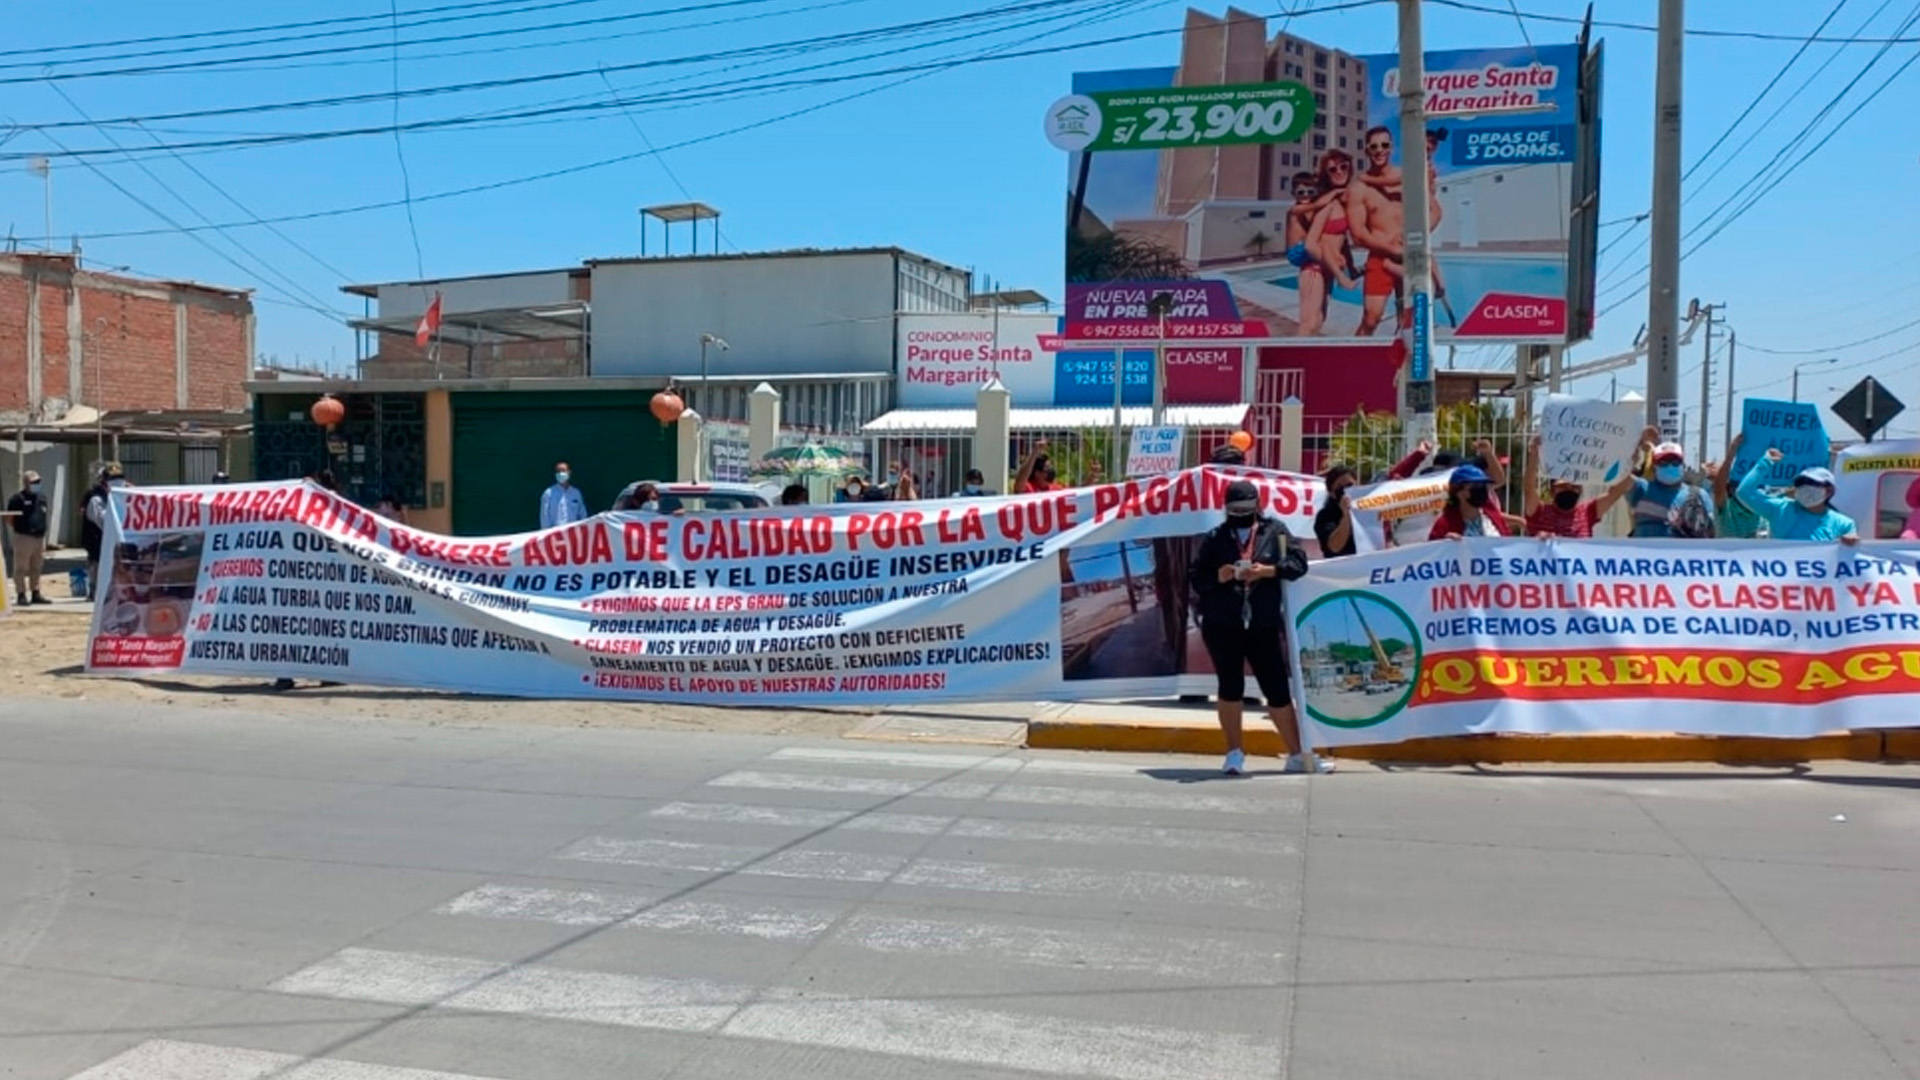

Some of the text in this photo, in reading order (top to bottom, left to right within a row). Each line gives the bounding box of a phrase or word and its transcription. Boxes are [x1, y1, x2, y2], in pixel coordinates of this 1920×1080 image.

[1423, 67, 1553, 93] rque Santa
[1138, 97, 1156, 105] DEL
[1467, 130, 1550, 145] DEPAS DE
[1465, 142, 1565, 160] 3 DORMS.
[1086, 290, 1147, 304] NUEVA
[1084, 304, 1210, 318] EN PRENTA
[1483, 303, 1549, 319] CLASEM
[907, 331, 994, 343] CONDOMINIO
[1094, 324, 1117, 337] 947
[1117, 324, 1140, 337] 556
[1172, 322, 1244, 337] 924 157 538
[907, 345, 1033, 363] Parque Santa
[1166, 351, 1228, 365] CLASEM
[906, 366, 1001, 386] Margarita
[1075, 361, 1098, 372] 947
[1125, 361, 1149, 372] 820
[1075, 374, 1098, 385] 924
[1125, 374, 1148, 385] 538
[123, 491, 200, 531] ¡SANTA
[209, 487, 380, 543] MARGARITA
[389, 527, 513, 568] QUIERE
[523, 521, 614, 567] AGUA
[624, 520, 669, 562] DE
[682, 514, 835, 562] CALIDAD
[846, 511, 925, 552] POR
[937, 507, 986, 544] LA
[997, 492, 1078, 542] QUE
[211, 558, 263, 580] QUEREMOS
[268, 558, 347, 581] CONECCIÓN
[350, 563, 367, 584] DE
[212, 533, 229, 552] EL
[234, 530, 284, 550] AGUA
[292, 531, 339, 554] QUE
[342, 541, 389, 564] NOS
[395, 558, 508, 589] BRINDAN
[512, 573, 547, 592] NO
[554, 573, 583, 592] ES
[591, 570, 697, 590] POTABLE
[704, 569, 720, 588] Y
[728, 567, 757, 587] EL
[765, 555, 881, 587] DESAGÜE
[889, 541, 1046, 577] INSERVIBLE
[1369, 567, 1396, 585] EL
[1402, 560, 1462, 582] AGUA
[1470, 558, 1503, 577] DE
[1509, 557, 1587, 577] SANTA
[1595, 558, 1744, 578] MARGARITA
[1752, 559, 1788, 578] NO
[1795, 560, 1826, 579] ES
[1834, 559, 1907, 580] APTA
[217, 586, 230, 605] AL
[232, 586, 267, 606] AGUA
[272, 588, 322, 609] TURBIA
[324, 590, 351, 611] QUE
[354, 592, 381, 613] NOS
[385, 594, 416, 615] DAN.
[592, 578, 969, 613] EXIGIMOS QUE LA EPS GRAU DE SOLUCIÓN A NUESTRA
[1431, 582, 1676, 613] INMOBILIARIA
[1686, 581, 1836, 612] CLASEM
[1847, 581, 1900, 608] YA
[211, 613, 219, 632] A
[222, 613, 247, 633] LAS
[251, 614, 346, 639] CONECCIONES
[351, 619, 448, 646] CLANDESTINAS
[452, 627, 478, 648] QUE
[481, 631, 540, 654] AFECTAN
[588, 616, 697, 634] PROBLEMÁTICA
[701, 618, 718, 633] DE
[723, 617, 761, 632] AGUA
[764, 616, 776, 631] Y
[1425, 616, 1557, 641] QUEREMOS
[1565, 616, 1636, 635] AGUA
[1643, 617, 1678, 634] DE
[1685, 617, 1800, 642] CALIDAD,
[584, 623, 966, 655] CLASEM NOS VENDIÓ UN PROYECTO CON DEFICIENTE
[189, 642, 245, 661] NUESTRA
[250, 643, 350, 667] URBANIZACIÓN
[590, 655, 685, 673] SANEAMIENTO
[689, 657, 709, 672] DE
[712, 656, 752, 672] AGUA
[754, 657, 766, 672] Y
[927, 641, 1050, 666] EXPLICACIONES!
[594, 672, 945, 693] ¡EXIGIMOS EL APOYO DE NUESTRAS AUTORIDADES!
[1420, 654, 1783, 698] ¡QUEREMOS
